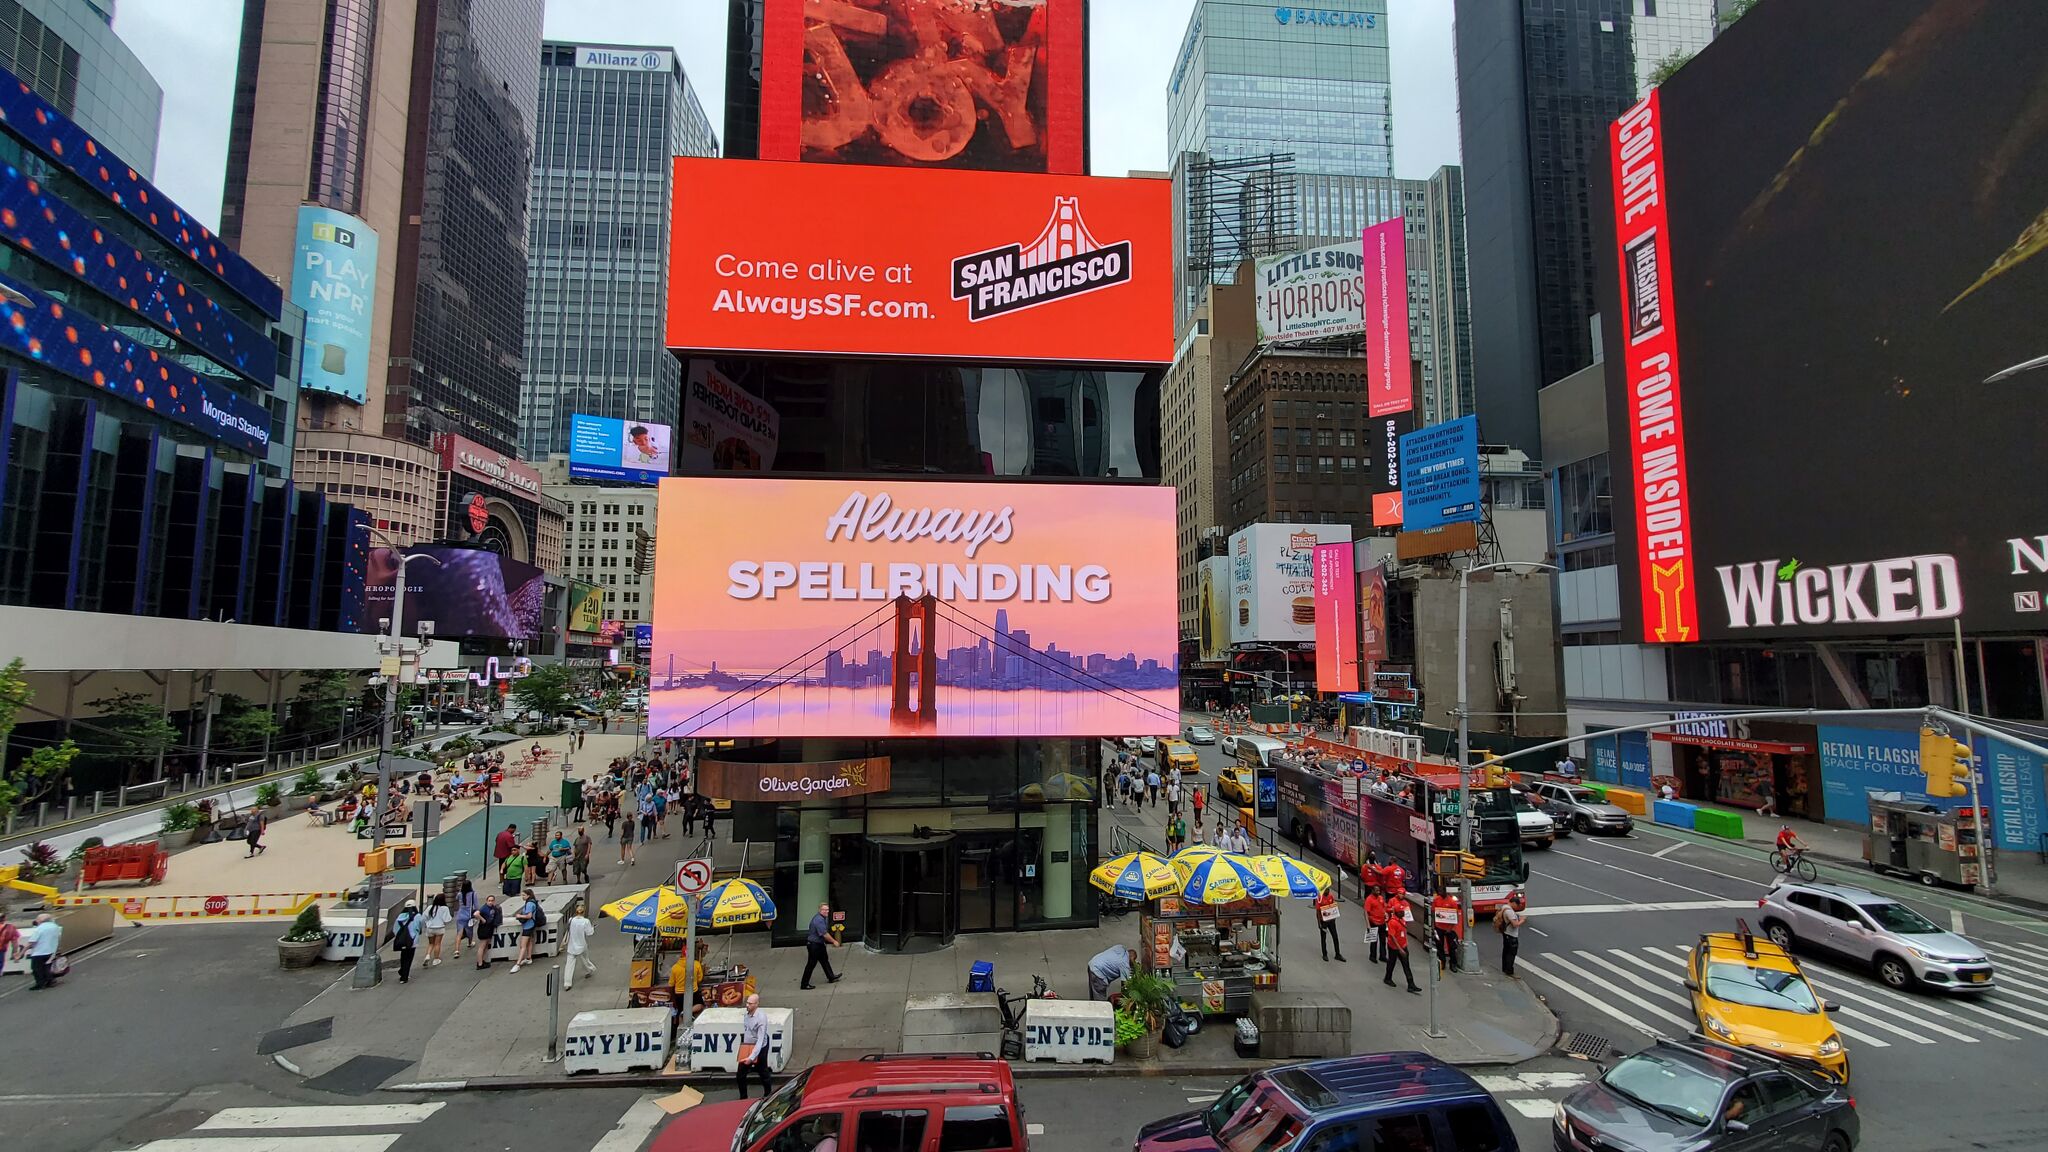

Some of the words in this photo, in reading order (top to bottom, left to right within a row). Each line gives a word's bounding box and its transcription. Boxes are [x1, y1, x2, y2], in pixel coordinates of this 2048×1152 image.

[1296, 8, 1376, 28] BARCLAYS
[587, 52, 638, 66] Allianz
[715, 254, 799, 279] Come
[808, 259, 876, 283] alive
[885, 263, 912, 284] at
[961, 252, 1014, 291] SAN
[1267, 251, 1321, 287] LITTLE
[1325, 250, 1364, 272] SHOP
[977, 252, 1123, 311] FRANCISCO
[318, 309, 332, 318] on
[712, 289, 936, 320] AlwaysSF.com.
[1268, 275, 1365, 333] HORRORS
[1264, 331, 1293, 342] Westside
[1294, 328, 1318, 338] Theatre
[1345, 322, 1360, 330] 43rd
[1286, 317, 1347, 331] LittleShopNYC.com
[1637, 351, 1675, 444] COME
[202, 400, 238, 428] Morgan
[238, 418, 269, 444] Stanley
[1406, 436, 1428, 447] ATTACKS
[1428, 434, 1436, 442] ON
[1436, 424, 1464, 440] ORTHODOX
[1407, 446, 1420, 456] JEWS
[1420, 442, 1433, 452] HAVE
[1434, 438, 1448, 449] MORE
[1450, 434, 1464, 445] THAN
[1387, 420, 1398, 486] 856-202-3429
[1407, 454, 1429, 466] DOUBLED
[1407, 469, 1420, 479] DEAR
[1420, 465, 1432, 475] NEW
[1432, 462, 1446, 472] YORK
[1447, 458, 1465, 468] TIMES
[1407, 478, 1425, 488] WORDS
[1426, 476, 1434, 484] DO
[1434, 471, 1450, 482] BREAK
[1408, 486, 1427, 498] PLEASE
[1427, 483, 1440, 494] STOP
[1440, 477, 1470, 490] ATTACKING
[1408, 497, 1419, 506] OUR
[1642, 445, 1684, 561] INSIDE!
[826, 490, 1015, 558] Always
[727, 560, 1112, 602] SPELLBINDING
[1320, 550, 1328, 596] 856-202-3429
[583, 614, 598, 622] YEARS
[1596, 748, 1616, 760] RETAIL
[1701, 738, 1735, 747] CHOCOLATE
[1736, 742, 1758, 750] WORLD
[1823, 741, 1864, 759] RETAIL
[1868, 746, 1920, 766] FLAGSH
[1596, 758, 1617, 769] SPACE
[1824, 756, 1860, 771] SPACE
[1864, 762, 1891, 774] FOR
[1894, 766, 1927, 778] LEAS
[2018, 754, 2032, 793] LEASE
[759, 776, 799, 792] Olive
[800, 776, 851, 794] Garden
[1997, 753, 2021, 805] FLAGSHIP
[1447, 804, 1454, 812] 47
[2022, 795, 2037, 818] FOR
[1334, 814, 1357, 834] MORE
[2001, 805, 2025, 844] RETAIL
[2026, 819, 2040, 848] SPACE
[410, 851, 416, 864] 2
[1148, 882, 1178, 896] SABRET
[1210, 878, 1236, 890] SABRETT
[205, 901, 226, 910] STOP
[722, 893, 750, 906] SABRETT
[716, 912, 758, 924] SABRETT
[326, 932, 364, 948] YPD
[492, 929, 547, 948] NYD
[578, 1032, 650, 1056] NYPD
[1038, 1026, 1102, 1046] NYPD
